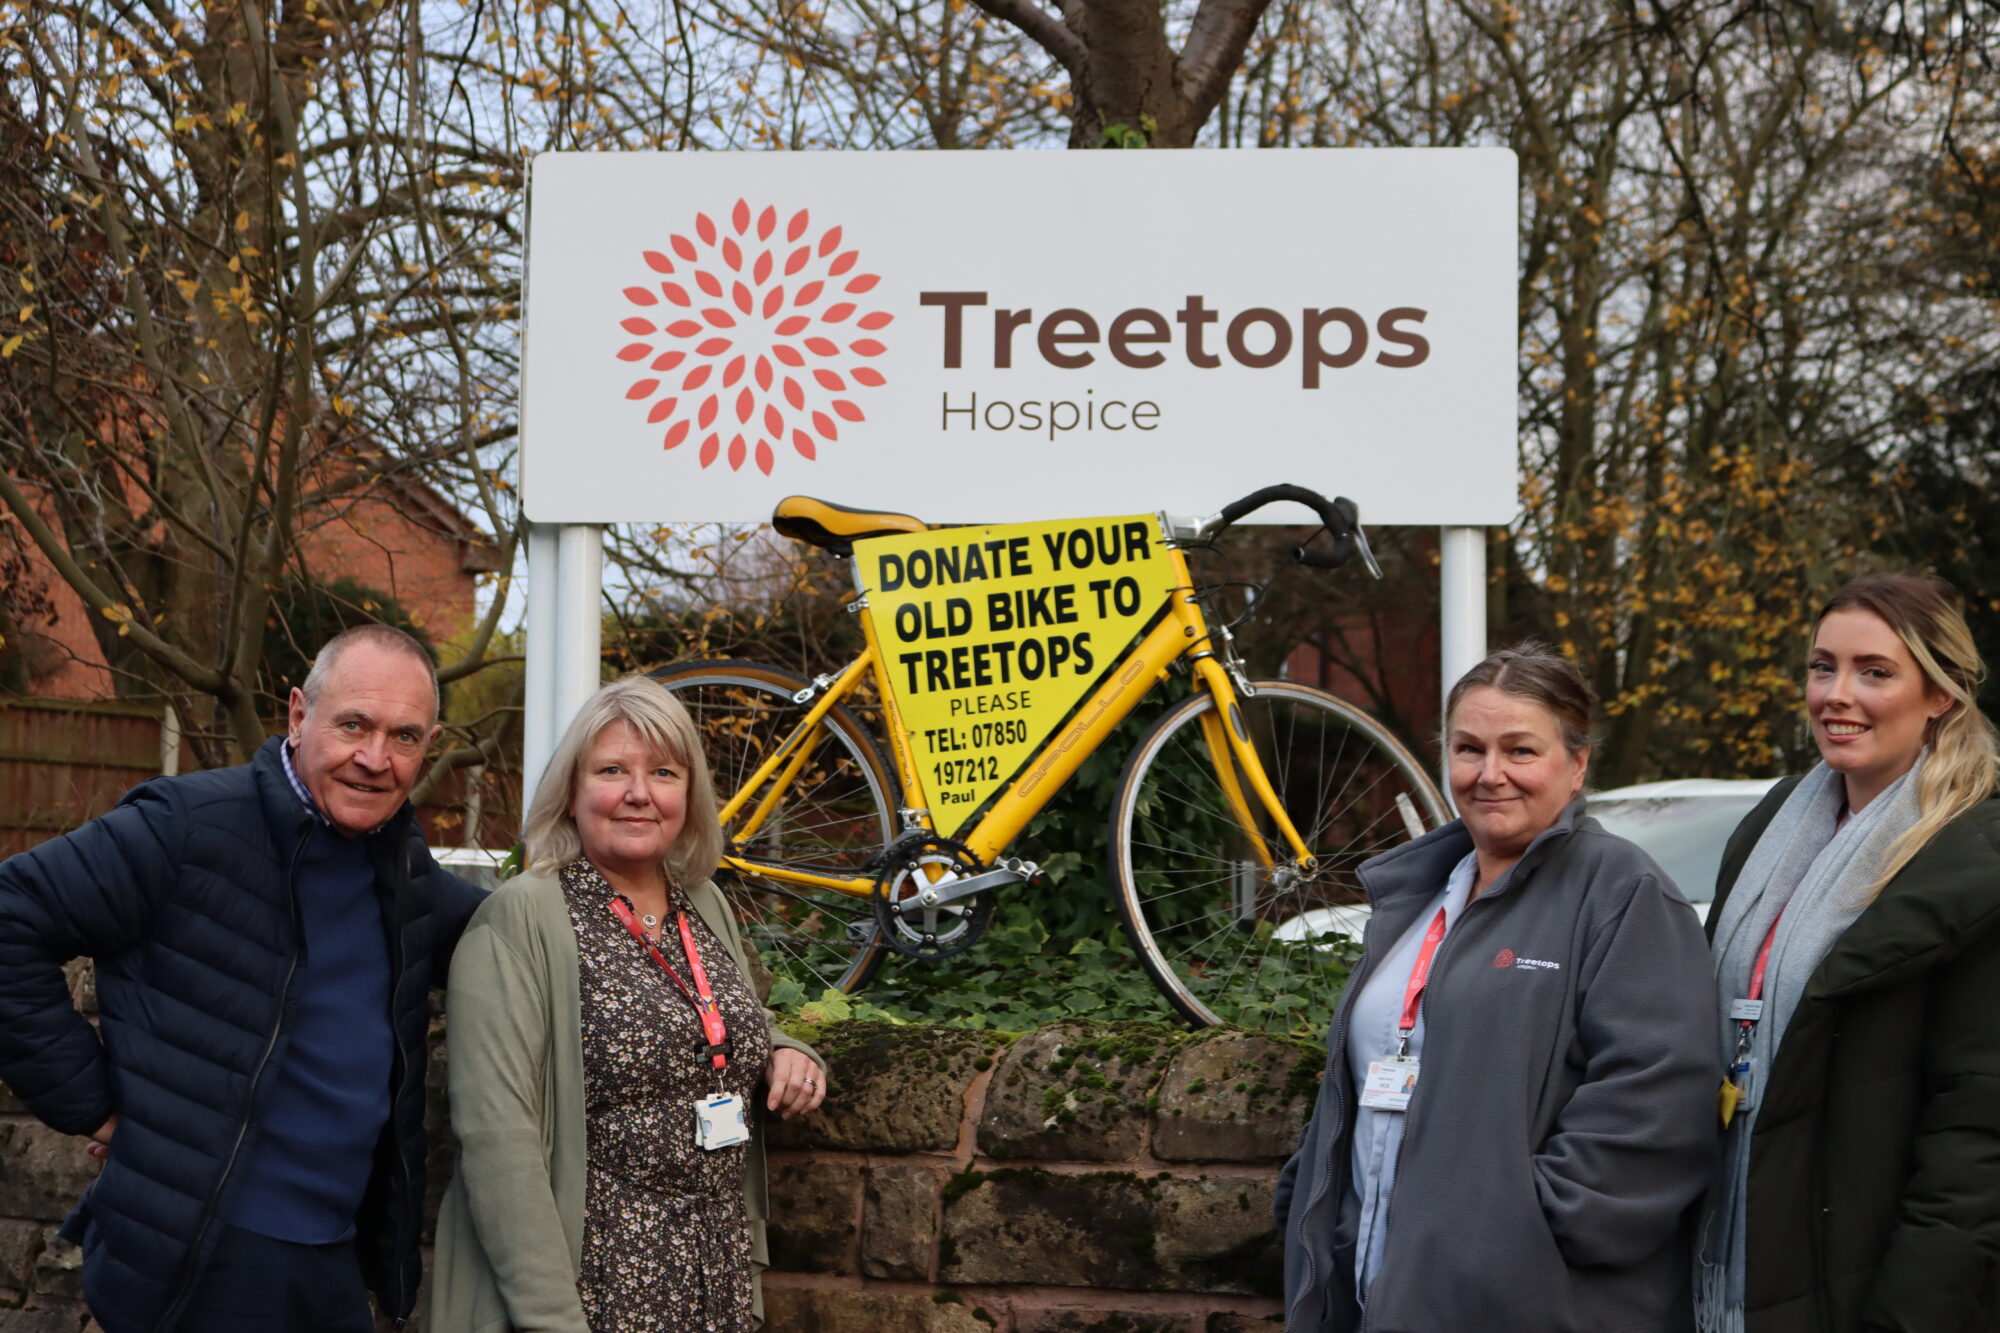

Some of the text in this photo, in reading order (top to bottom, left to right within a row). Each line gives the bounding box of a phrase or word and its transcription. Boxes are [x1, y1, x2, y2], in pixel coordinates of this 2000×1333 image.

[919, 291, 1431, 390] Treetops
[942, 388, 1161, 442] Hospice
[878, 521, 1152, 593] DONATE YOUR
[895, 575, 1142, 643] OLD BIKE TO
[898, 631, 1094, 695] TREETOPS
[950, 690, 1032, 717] PLEASE
[924, 718, 1027, 754] TEL: 07850
[933, 755, 999, 786] 197212
[940, 788, 976, 805] Paul
[1515, 957, 1560, 970] Treetops
